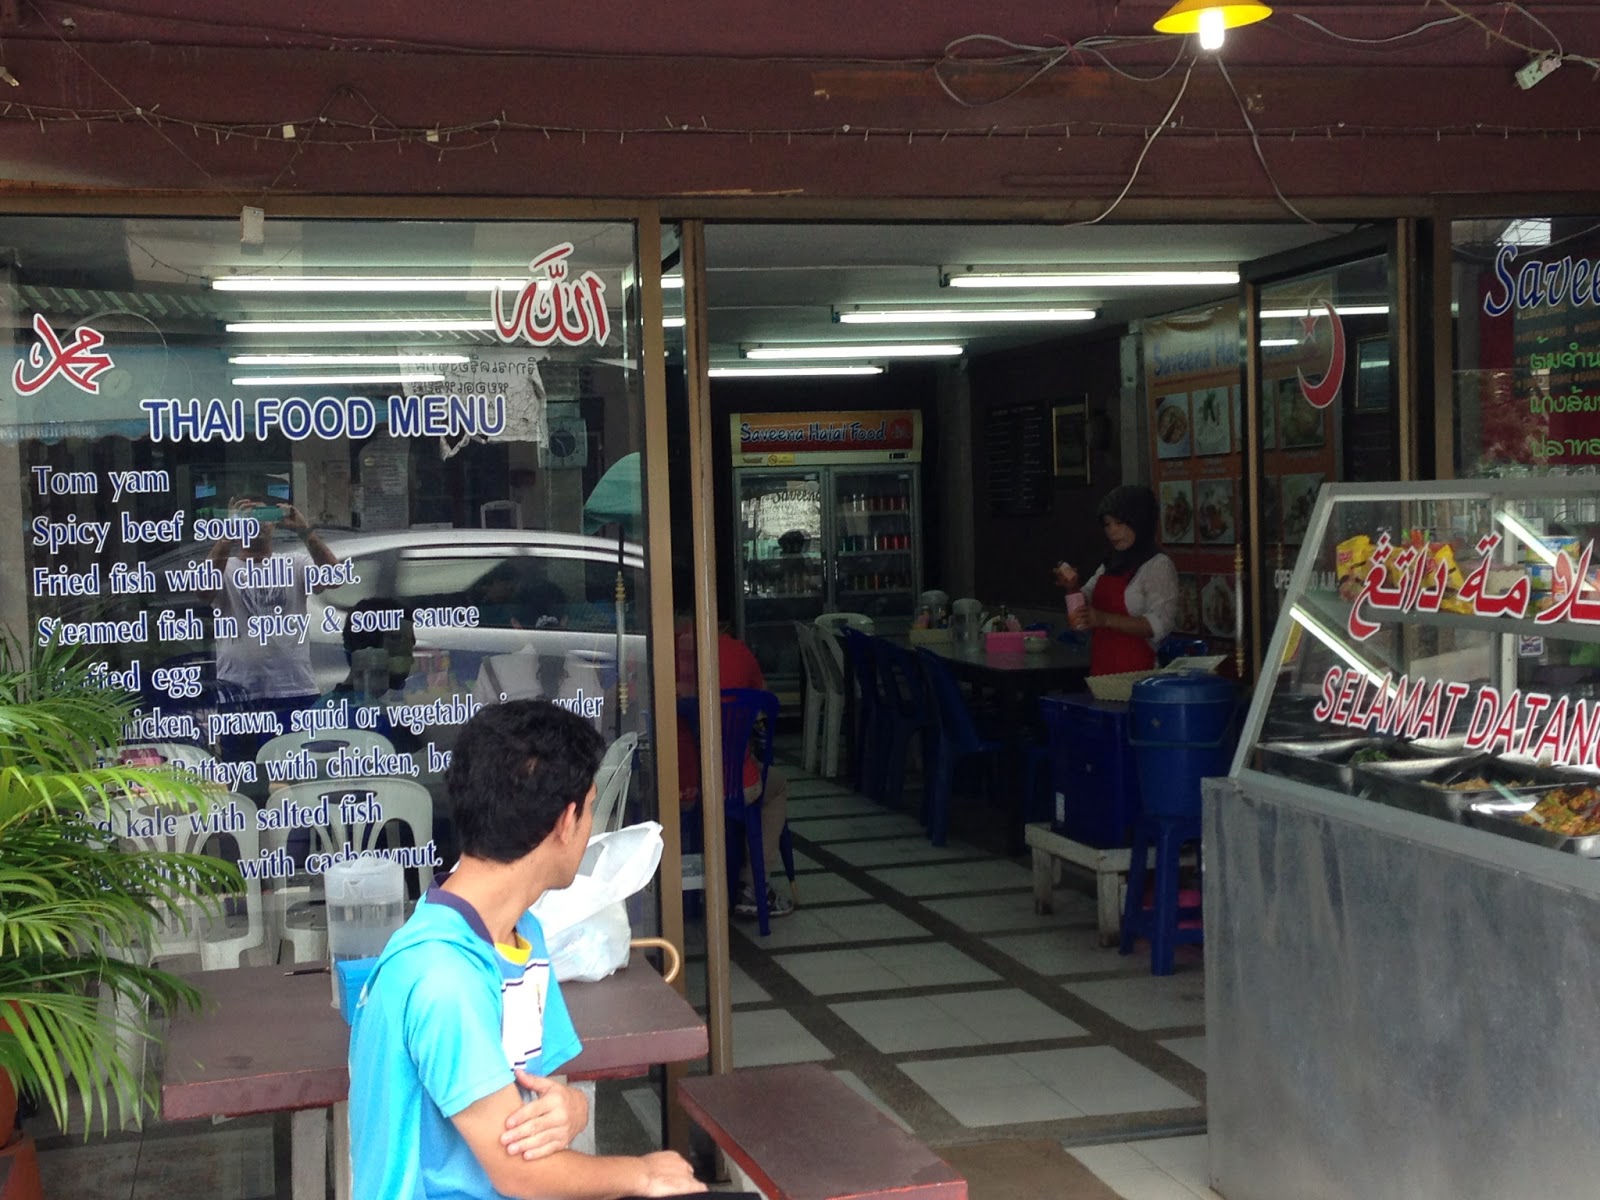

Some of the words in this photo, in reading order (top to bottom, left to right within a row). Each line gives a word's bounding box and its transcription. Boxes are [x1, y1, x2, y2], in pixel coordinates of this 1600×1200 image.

[140, 398, 244, 443] THAI
[256, 396, 376, 441] FOOD
[389, 394, 506, 437] MENU
[740, 422, 804, 443] Saveena
[807, 421, 847, 442] Halal
[850, 420, 887, 442] Food
[32, 465, 98, 496] Tom
[109, 469, 170, 504] yam
[32, 514, 111, 554] Spicy
[122, 511, 185, 544] beef
[194, 514, 260, 549] soup
[33, 563, 100, 597] Fried
[110, 562, 156, 595] fish
[166, 560, 224, 593] with
[232, 557, 294, 590] chilli
[304, 559, 361, 596] past.
[38, 610, 148, 646] Steamed
[158, 609, 203, 642] fish
[213, 607, 239, 640] in
[248, 607, 311, 646] spicy
[321, 607, 342, 634] &
[351, 607, 404, 633] sour
[413, 604, 480, 630] sauce
[151, 665, 202, 698] egg
[117, 706, 201, 742] hicken,
[208, 708, 284, 744] prawn,
[290, 700, 349, 738] squid
[356, 702, 380, 729] or
[1313, 665, 1470, 741] SELAMAT
[265, 749, 317, 783] with
[325, 742, 421, 779] chicken,
[126, 806, 179, 841] kale
[189, 800, 246, 836] with
[256, 795, 330, 830] salted
[338, 792, 384, 827] fish
[238, 848, 298, 882] with
